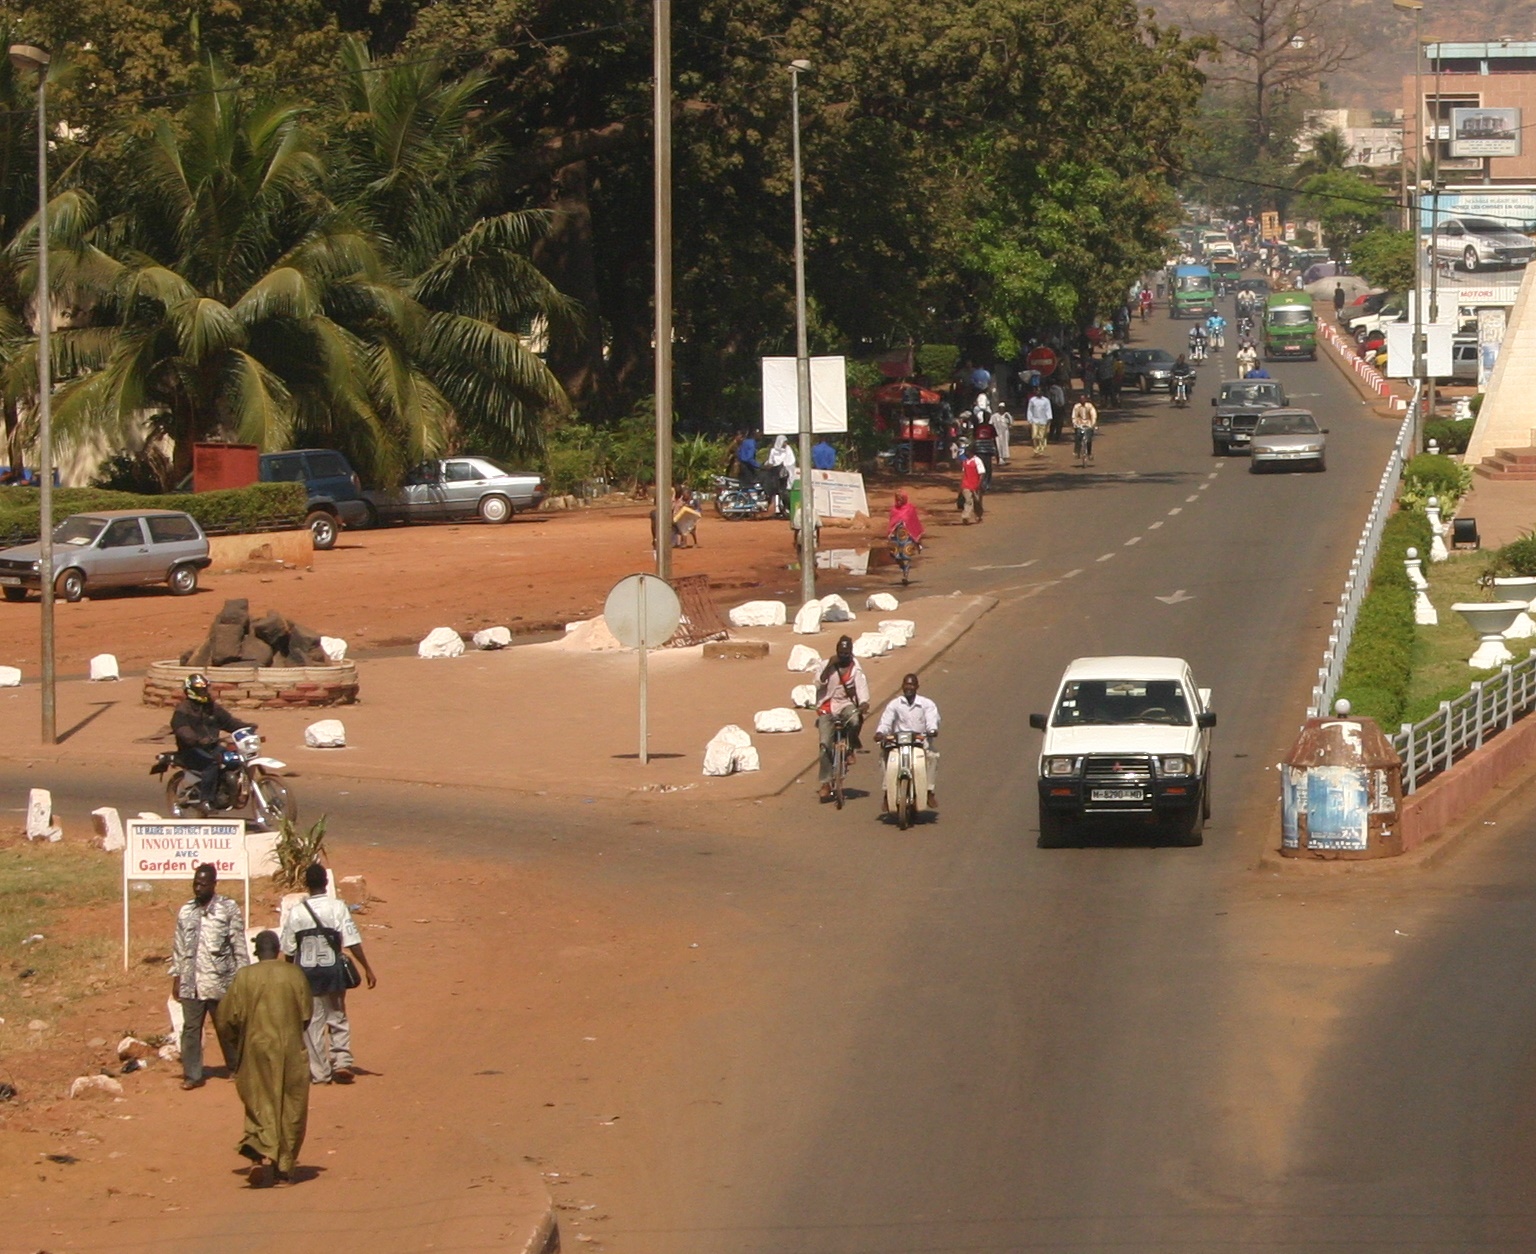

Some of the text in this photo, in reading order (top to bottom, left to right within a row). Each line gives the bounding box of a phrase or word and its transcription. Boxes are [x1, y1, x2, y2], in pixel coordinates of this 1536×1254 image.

[1460, 290, 1493, 298] MOTORS
[141, 838, 232, 849] INNOVE LA VILLE
[175, 850, 199, 858] AVEC
[139, 859, 236, 872] Garden Cter
